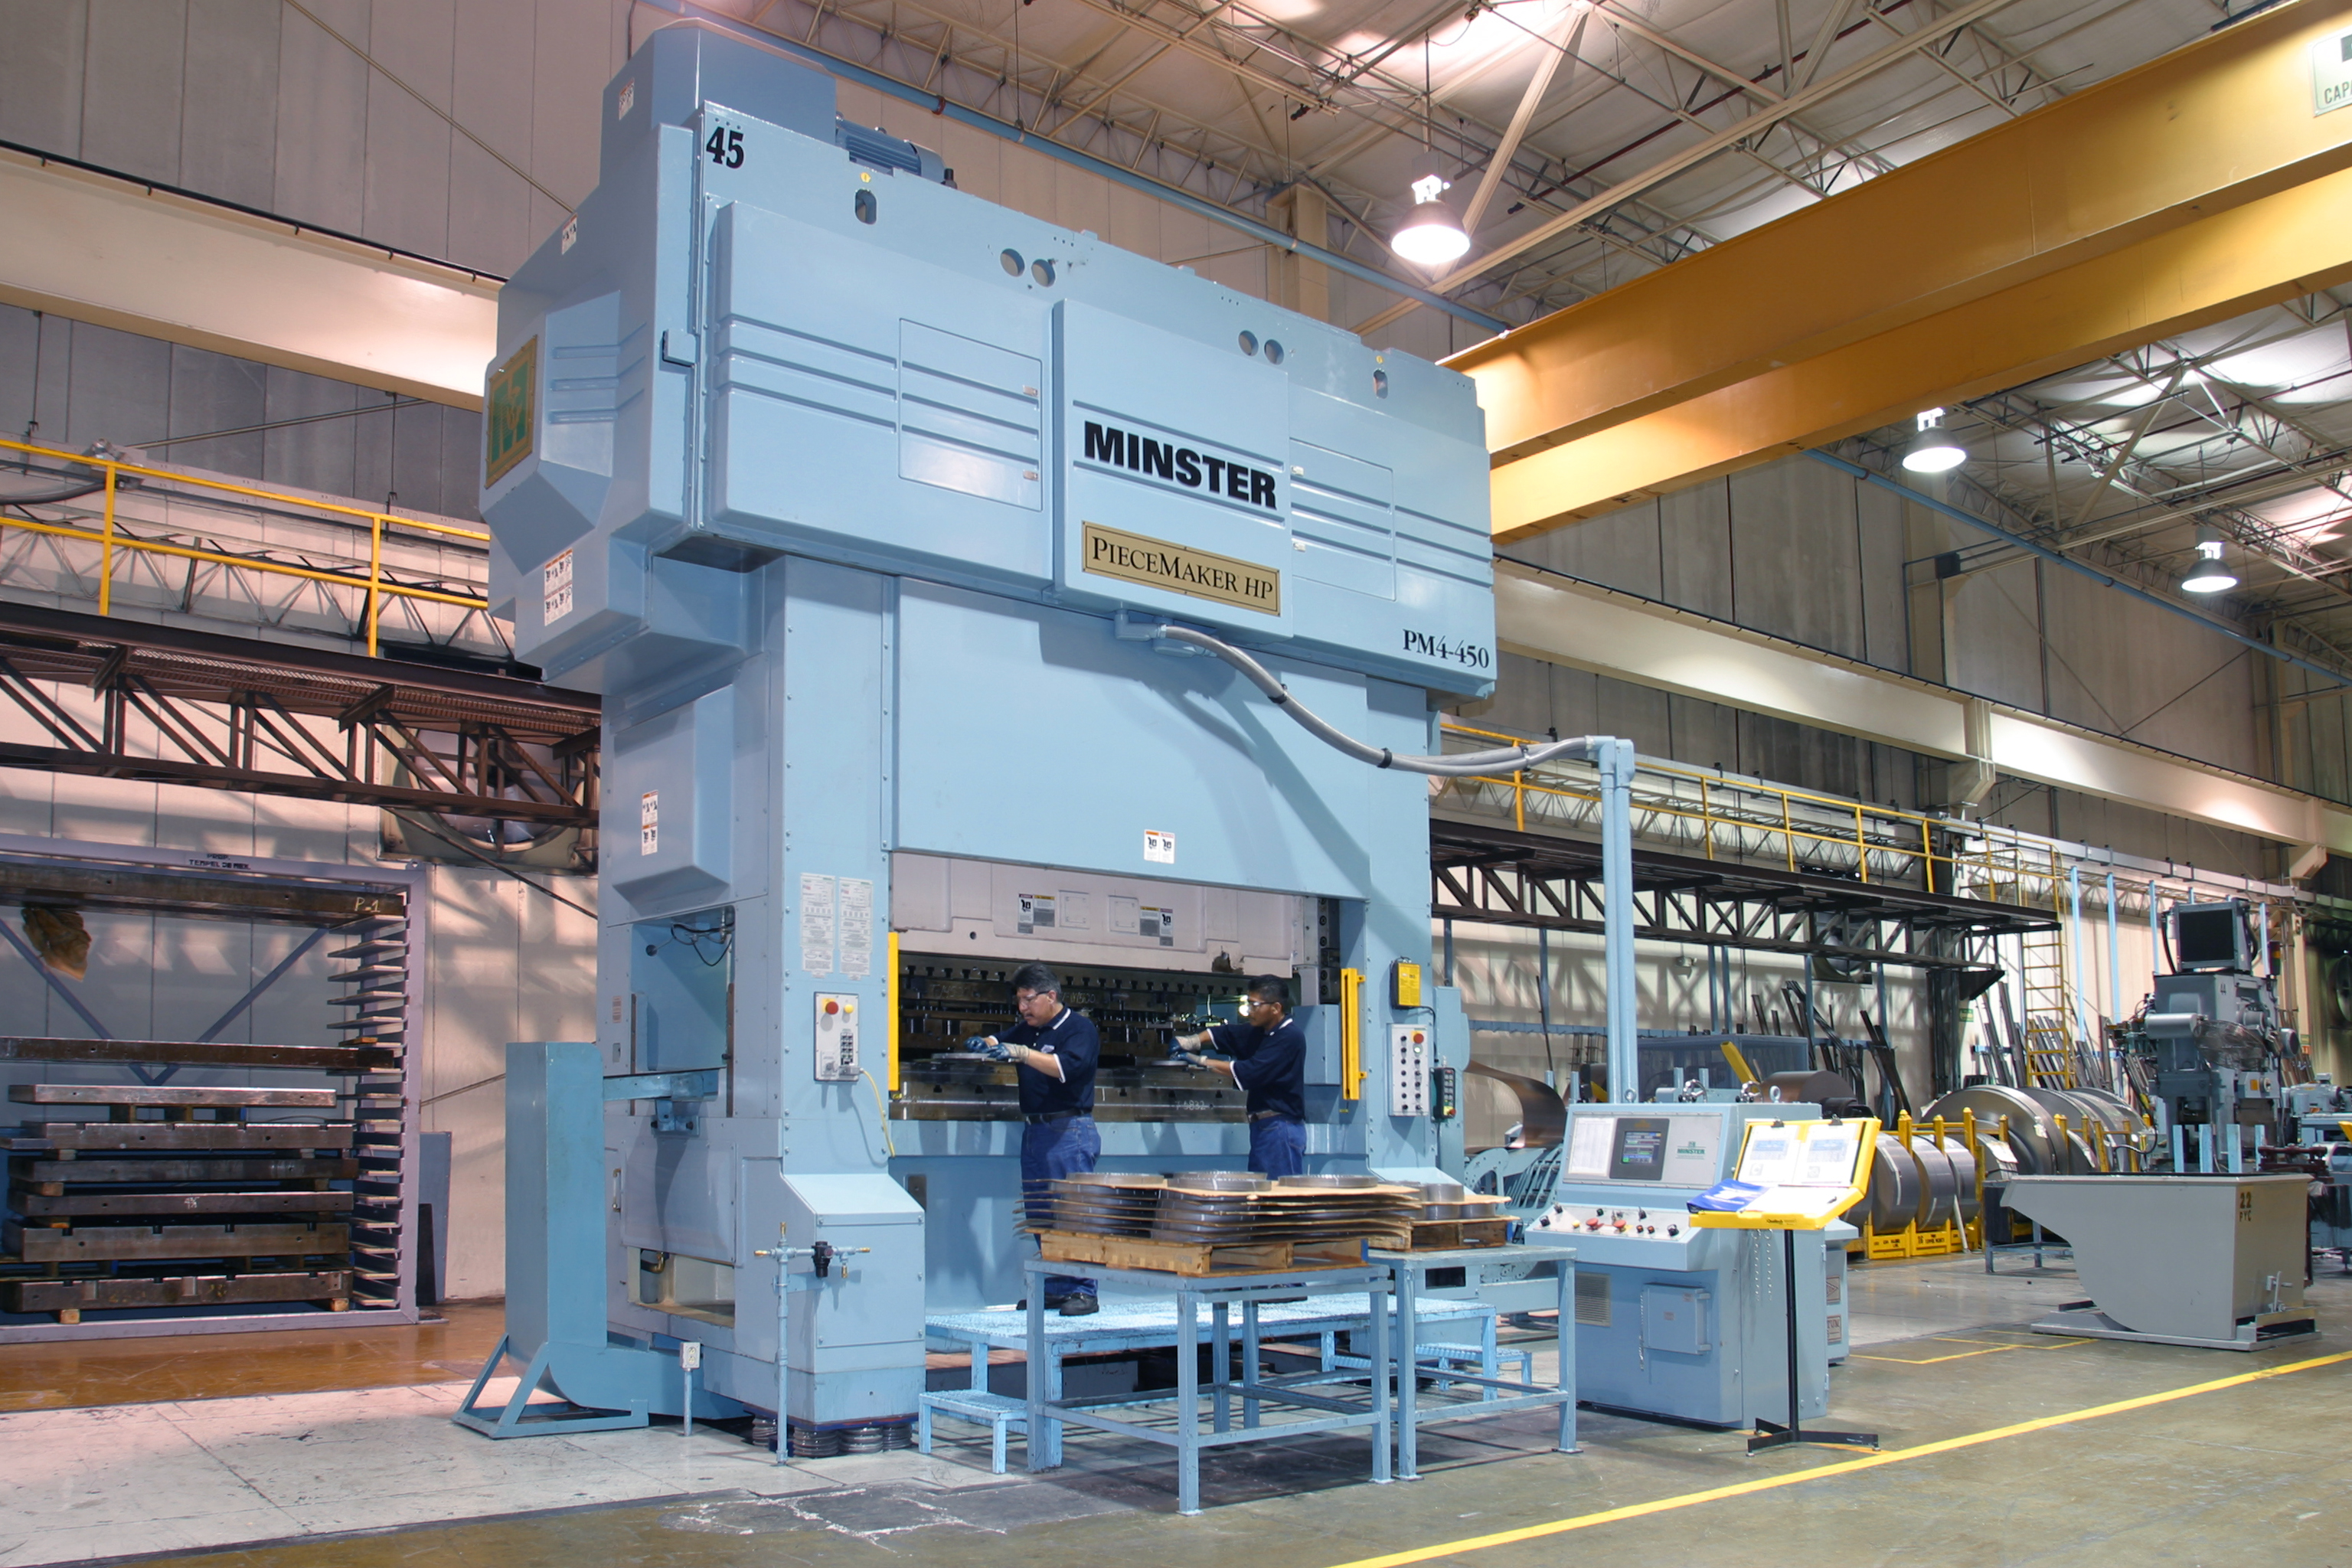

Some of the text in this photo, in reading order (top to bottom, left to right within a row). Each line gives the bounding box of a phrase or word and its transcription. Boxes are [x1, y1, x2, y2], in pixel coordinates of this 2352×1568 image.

[2324, 80, 2352, 104] CAP
[706, 126, 745, 169] 45
[1084, 420, 1277, 511] MINSTER
[1243, 576, 1273, 599] HP
[1402, 629, 1490, 669] PM4-450
[2220, 983, 2227, 996] 44
[2239, 1191, 2252, 1209] 22
